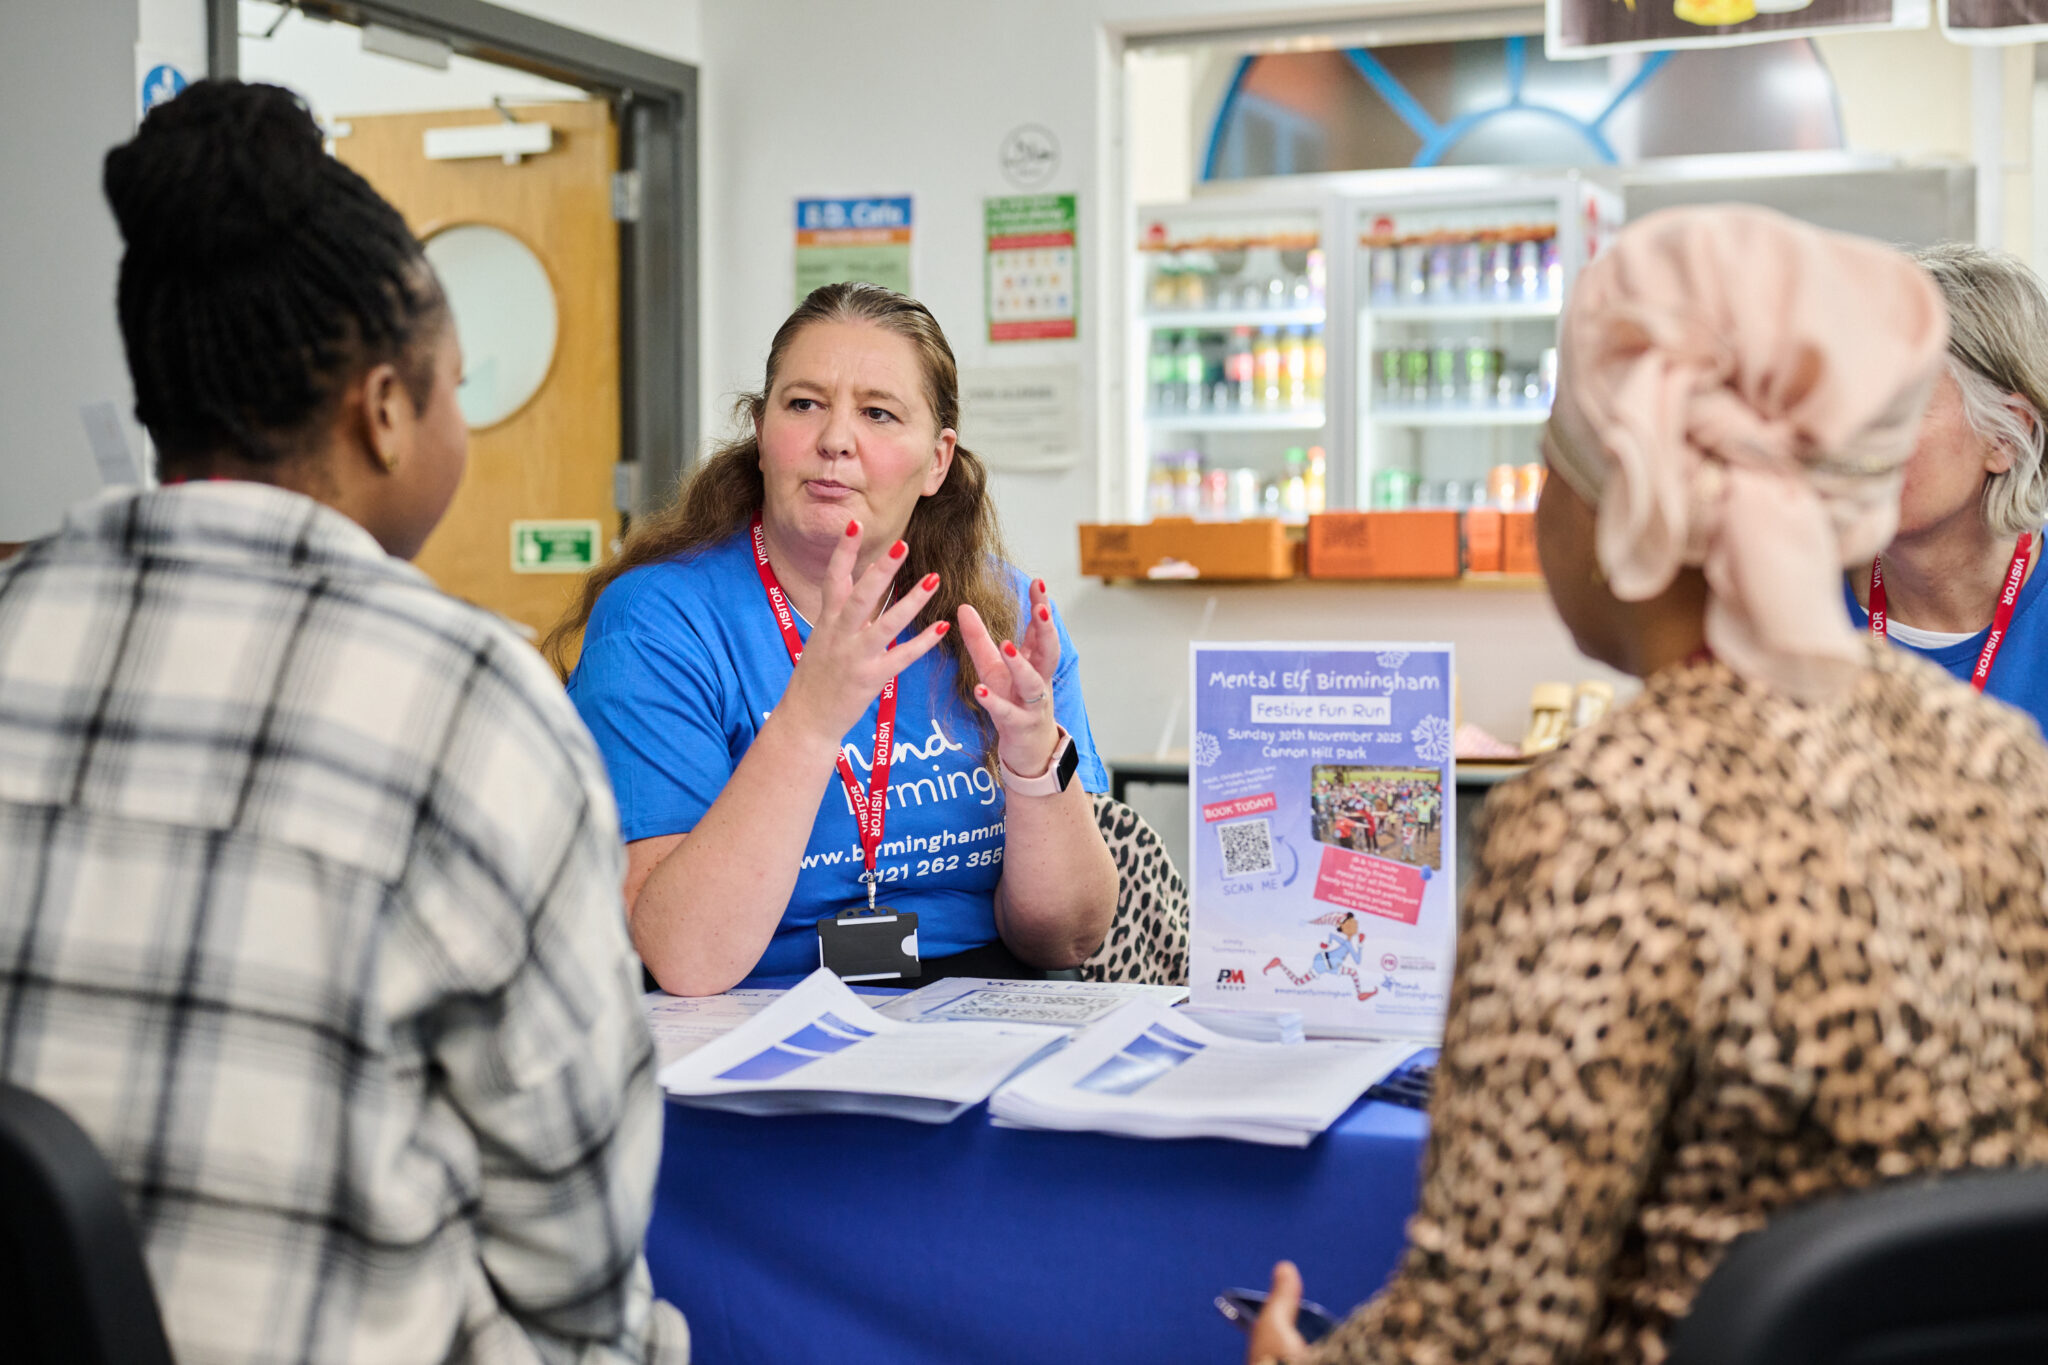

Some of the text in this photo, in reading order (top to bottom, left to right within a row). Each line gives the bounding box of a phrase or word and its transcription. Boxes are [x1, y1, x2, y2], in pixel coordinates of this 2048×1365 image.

[754, 524, 769, 566] VISITOR
[2002, 558, 2025, 606] VISITOR
[769, 586, 793, 631] VISITOR
[1976, 630, 2002, 678] VISITOR
[1208, 669, 1440, 696] Mental Elf Birmingham
[1256, 702, 1312, 718] Festive
[1353, 704, 1385, 718] Run
[876, 721, 891, 766] VISITOR
[1227, 728, 1275, 745] Sunday
[1279, 728, 1305, 742] 30th
[1307, 730, 1374, 743] November
[1262, 745, 1367, 760] Cannon Hill Park
[870, 789, 884, 838] VISITOR
[1204, 805, 1234, 819] BOOK
[916, 855, 959, 877] 262
[1223, 879, 1278, 896] SCAN ME
[987, 980, 1054, 990] Work
